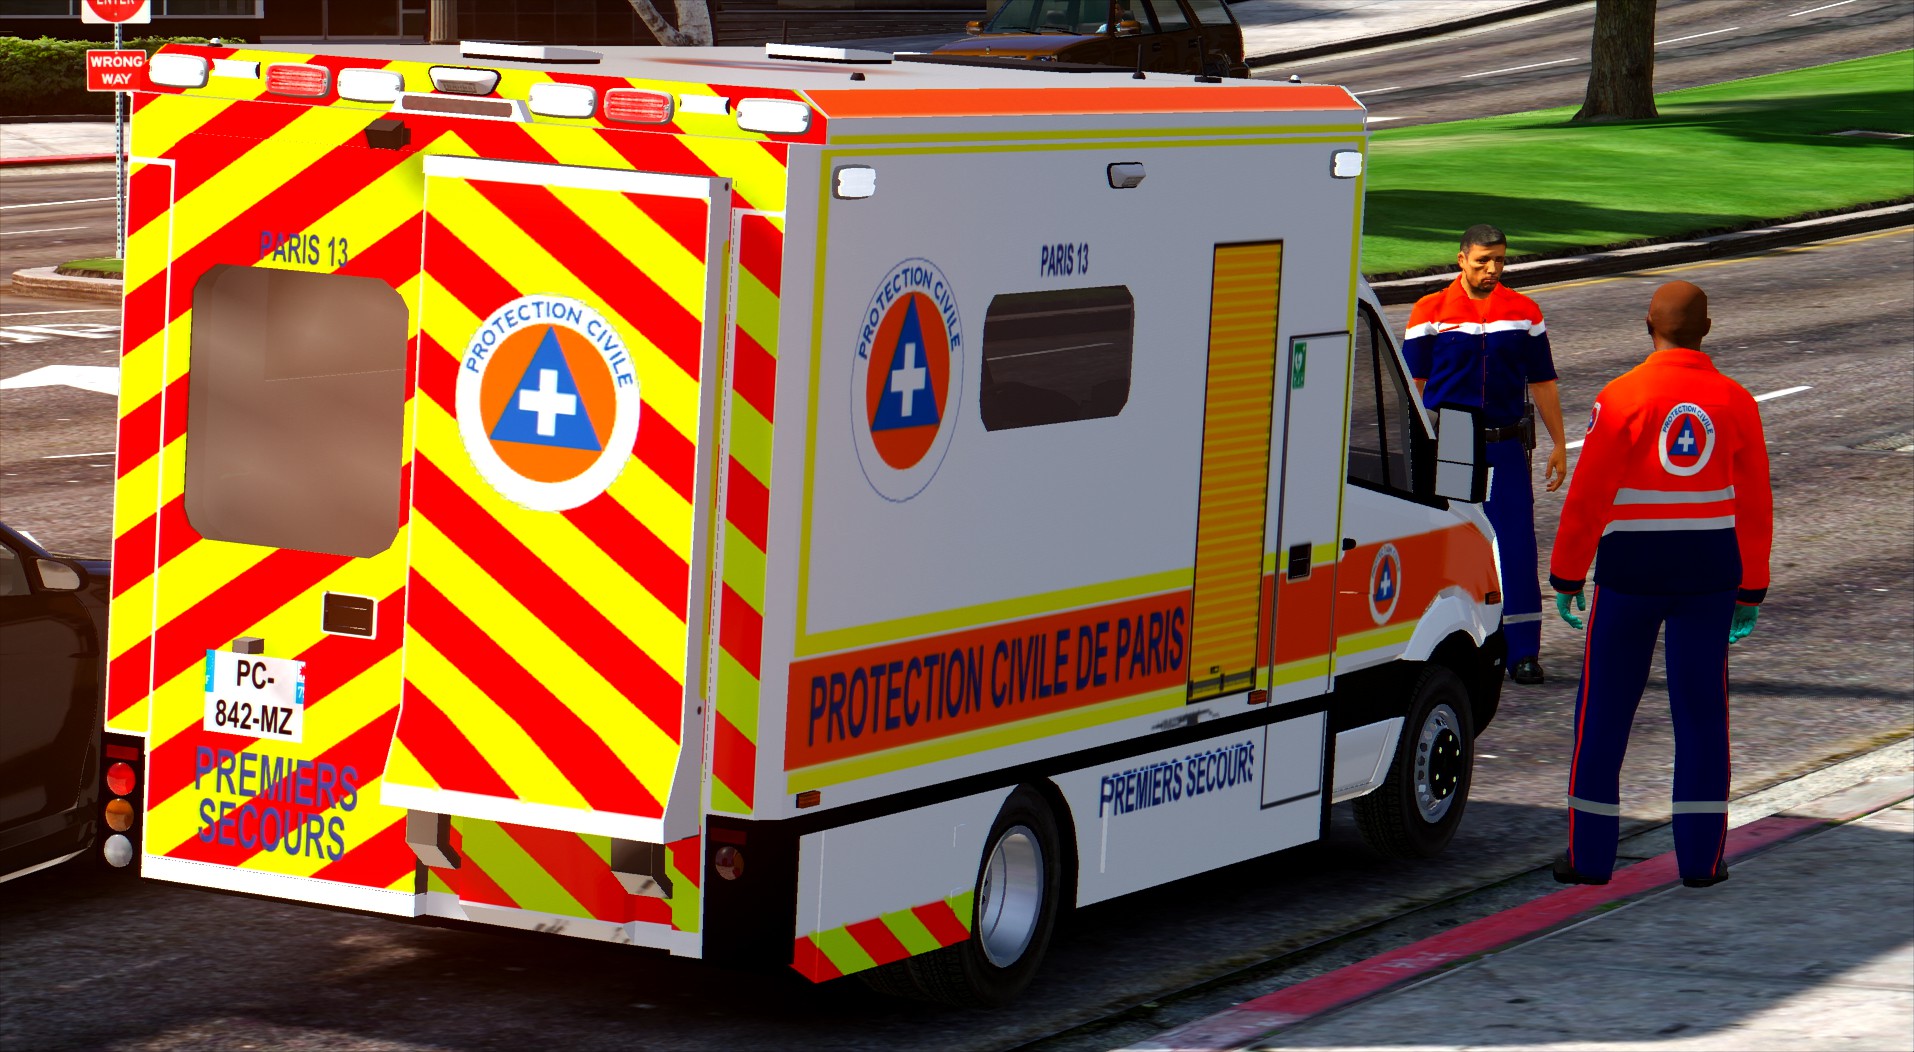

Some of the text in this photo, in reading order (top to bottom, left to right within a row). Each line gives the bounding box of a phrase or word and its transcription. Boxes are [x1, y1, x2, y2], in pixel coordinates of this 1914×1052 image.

[90, 56, 143, 67] WRONG
[101, 73, 132, 85] WAY
[260, 230, 348, 268] PARIS 13
[1041, 242, 1089, 277] PARIS 13
[858, 266, 960, 360] PROTECTION CIVILE
[466, 301, 634, 388] PROTECTION CIVILE
[1662, 405, 1714, 435] PROTECTION CIVILE
[236, 659, 275, 689] PC-
[808, 606, 1185, 747] PROTECTION CIVILE DE PARIS
[215, 699, 293, 736] 842-MZ
[195, 745, 359, 812] PREMIERS
[1099, 758, 1183, 818] PREMIERS
[198, 797, 345, 862] SECOURS
